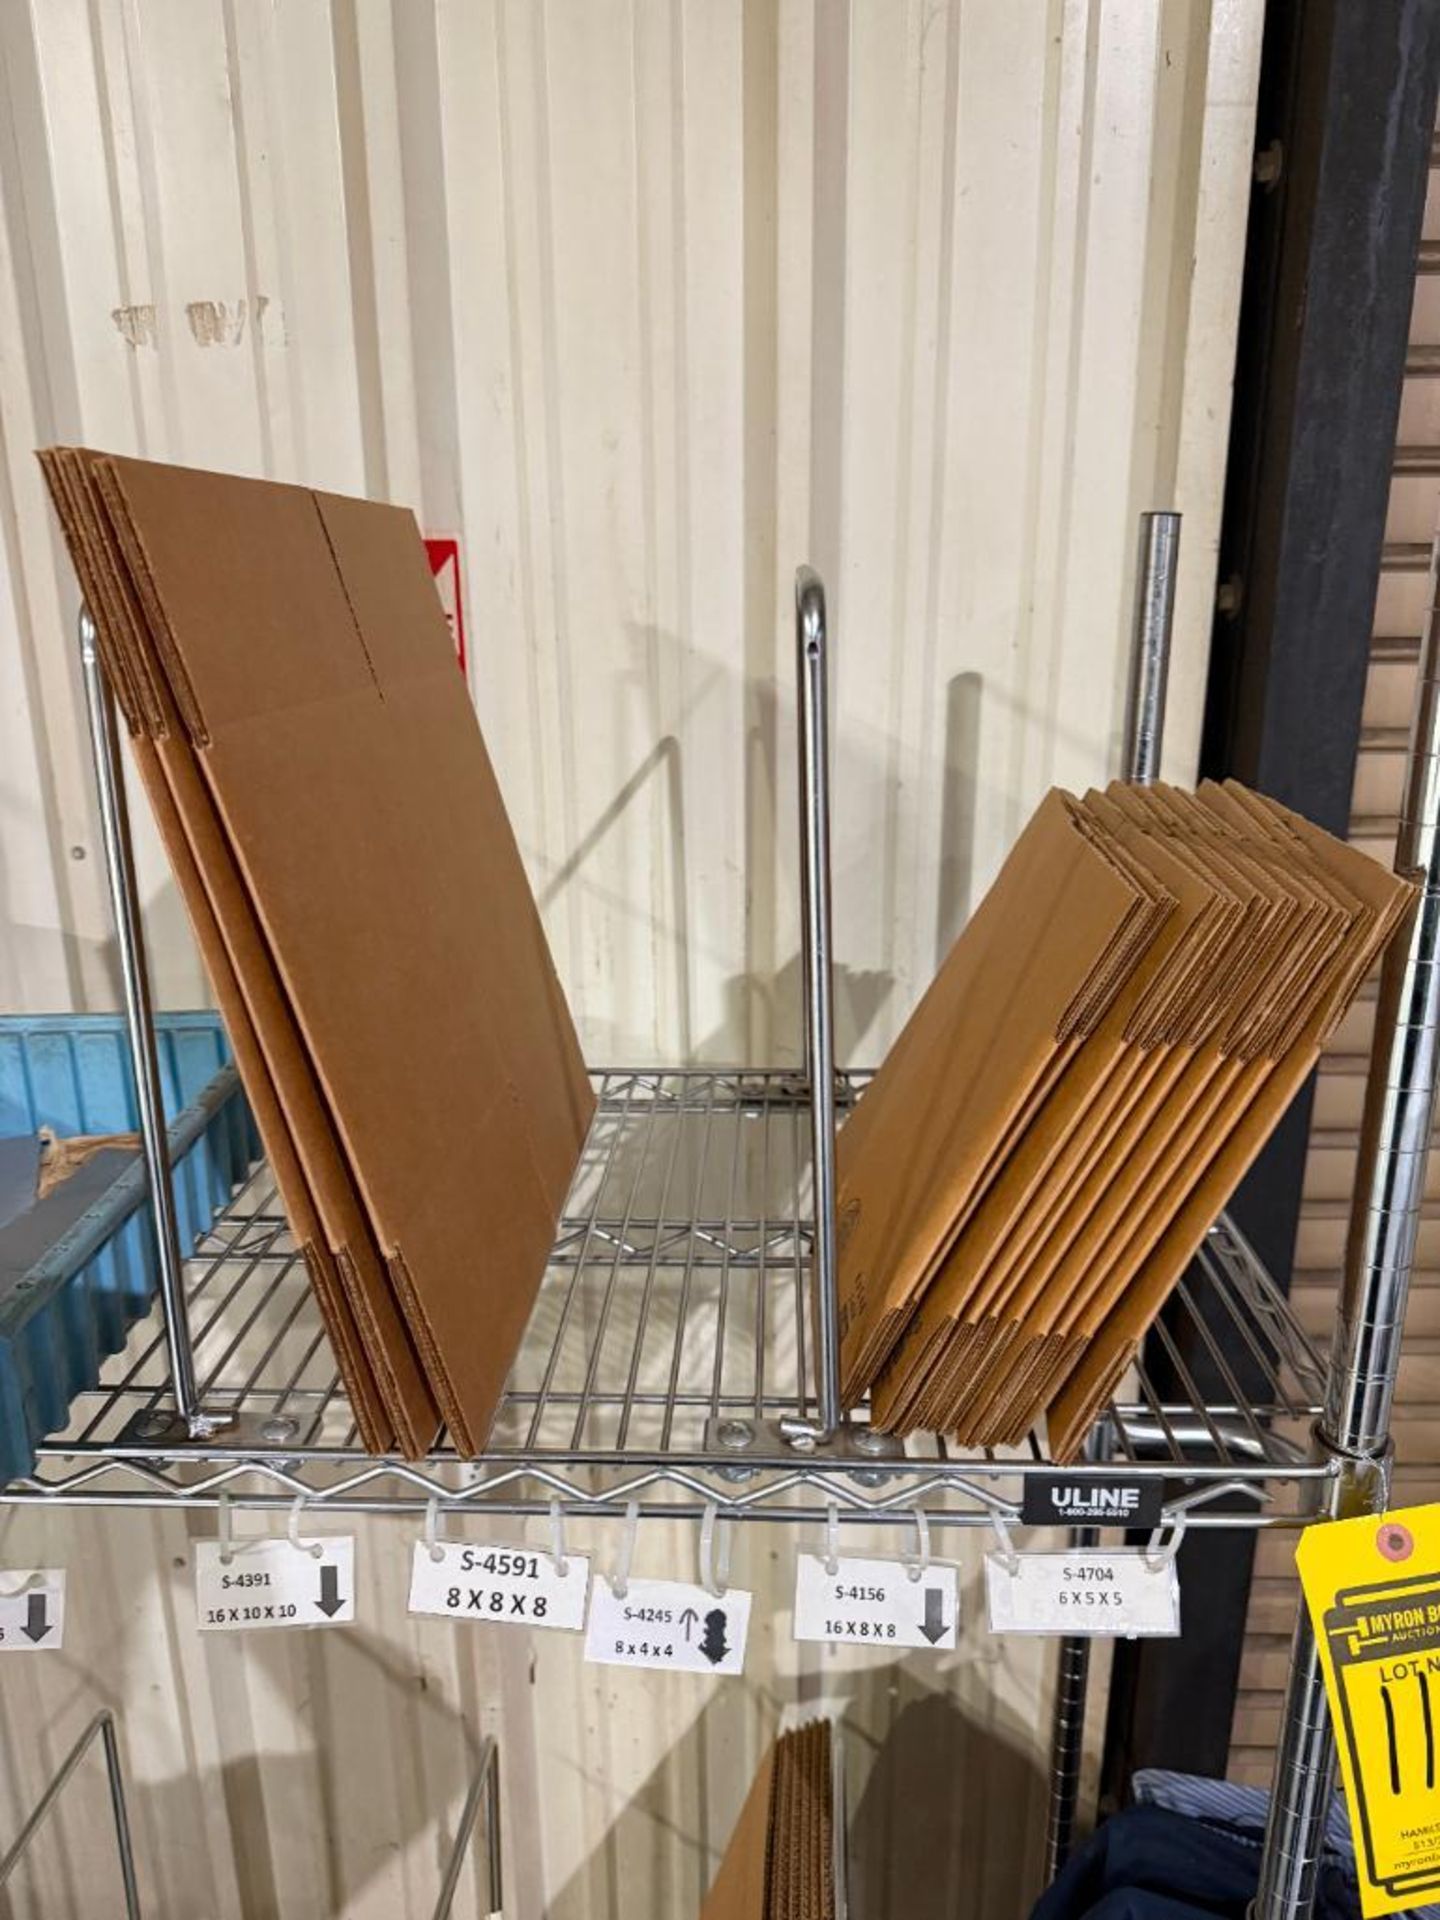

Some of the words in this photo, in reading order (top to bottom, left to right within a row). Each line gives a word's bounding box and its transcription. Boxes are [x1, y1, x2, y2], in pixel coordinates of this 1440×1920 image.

[1051, 1486, 1140, 1508] ULINE
[460, 1550, 540, 1579] S-4591
[222, 1573, 271, 1589] S-4391
[1063, 1567, 1114, 1581] S-4704
[447, 1587, 461, 1608] 8
[467, 1589, 484, 1610] X
[489, 1591, 504, 1612] 8
[510, 1594, 527, 1615] X
[533, 1597, 547, 1617] 8
[835, 1585, 886, 1602] S-4156
[1059, 1591, 1068, 1605] 6
[1072, 1592, 1081, 1605] X
[1085, 1592, 1094, 1605] 5
[1099, 1592, 1109, 1605] X
[1113, 1592, 1122, 1606] 5
[207, 1608, 226, 1623] 16
[229, 1607, 239, 1621] X
[243, 1606, 261, 1620] 10
[264, 1605, 275, 1619] X
[279, 1604, 297, 1618] 10
[623, 1607, 673, 1624] S-4245
[1370, 1607, 1425, 1634] MYRON
[1427, 1604, 1440, 1623] B
[825, 1620, 843, 1634] 16
[846, 1621, 857, 1636] X
[860, 1622, 869, 1636] 8
[873, 1623, 883, 1637] X
[887, 1624, 896, 1638] 8
[615, 1641, 624, 1653] 8
[627, 1644, 636, 1655] x
[639, 1642, 649, 1656] 4
[652, 1645, 661, 1657] x
[664, 1644, 673, 1657] 4
[1380, 1660, 1419, 1683] LOT
